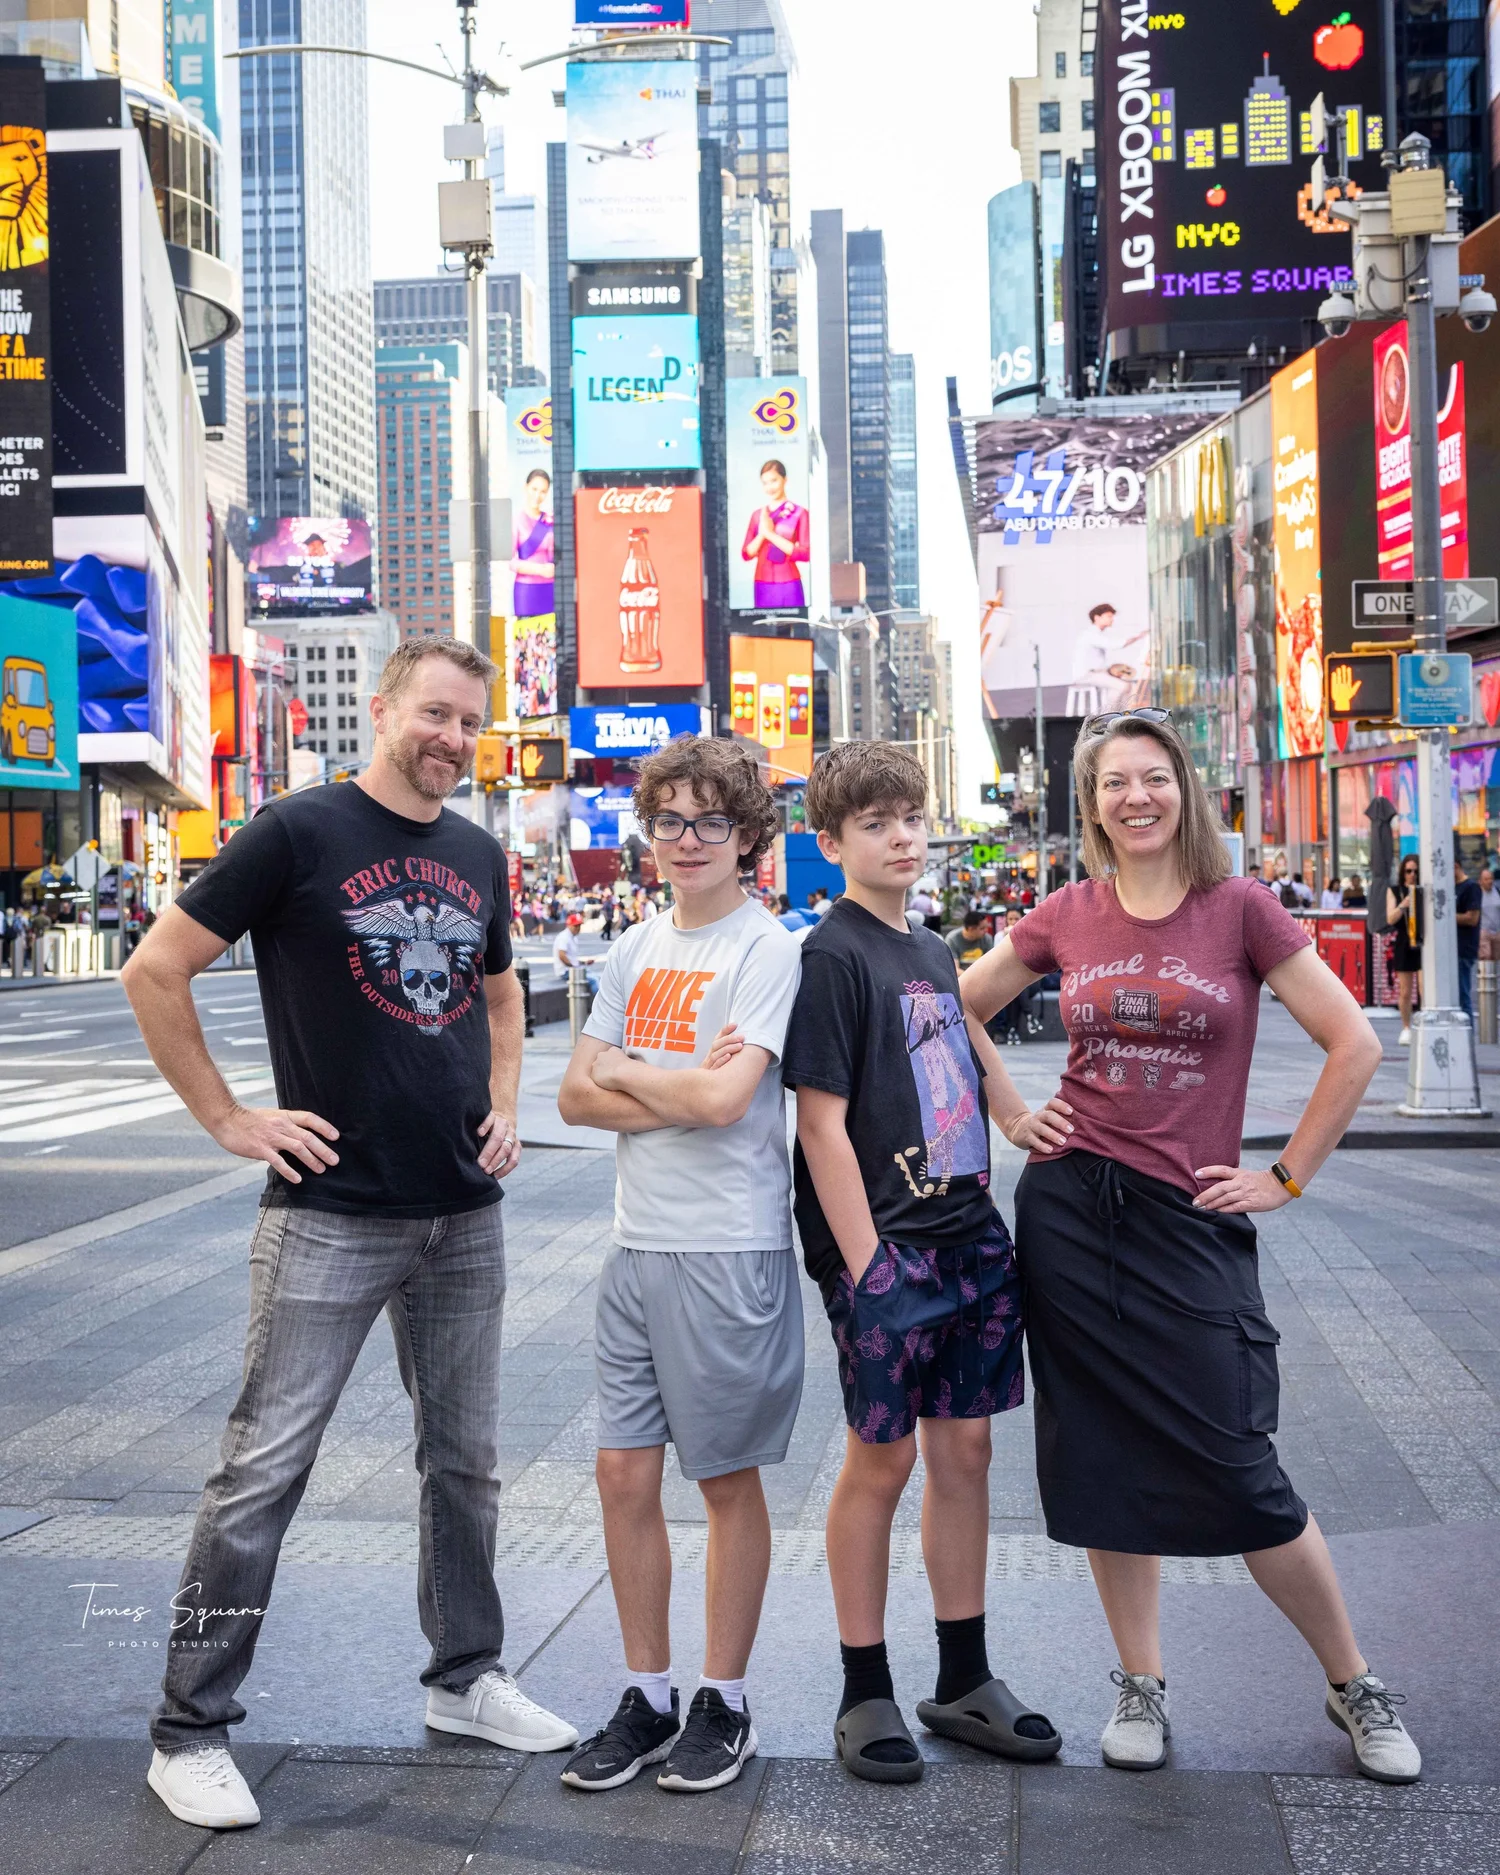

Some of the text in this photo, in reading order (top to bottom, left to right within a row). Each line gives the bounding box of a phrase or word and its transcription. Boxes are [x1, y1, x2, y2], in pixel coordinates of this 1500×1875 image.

[1148, 13, 1185, 30] NYC
[1118, 0, 1156, 293] LG XBOOM XL
[1176, 222, 1240, 248] NYC
[1161, 266, 1353, 297] IMES SQUAR
[0, 289, 23, 312] HE
[587, 286, 681, 306] SAMSUNG
[13, 334, 26, 357] A
[1004, 518, 1035, 532] ABU
[1375, 594, 1475, 612] ONE AY
[596, 717, 670, 736] TRIVIA
[339, 856, 483, 915] ERIC CHURCH
[346, 942, 365, 981] THE
[360, 981, 434, 1027] OUTSIDERS
[436, 995, 473, 1027] REVIVAL
[381, 968, 464, 990] 20 23
[1157, 955, 1231, 1003] Four
[625, 968, 716, 1053] NIKE
[1118, 1005, 1148, 1016] FOUR
[1119, 996, 1148, 1006] FINAL
[1071, 1003, 1207, 1032] 20 24
[1166, 1029, 1189, 1038] APRIL
[1083, 1037, 1203, 1066] Phoenix
